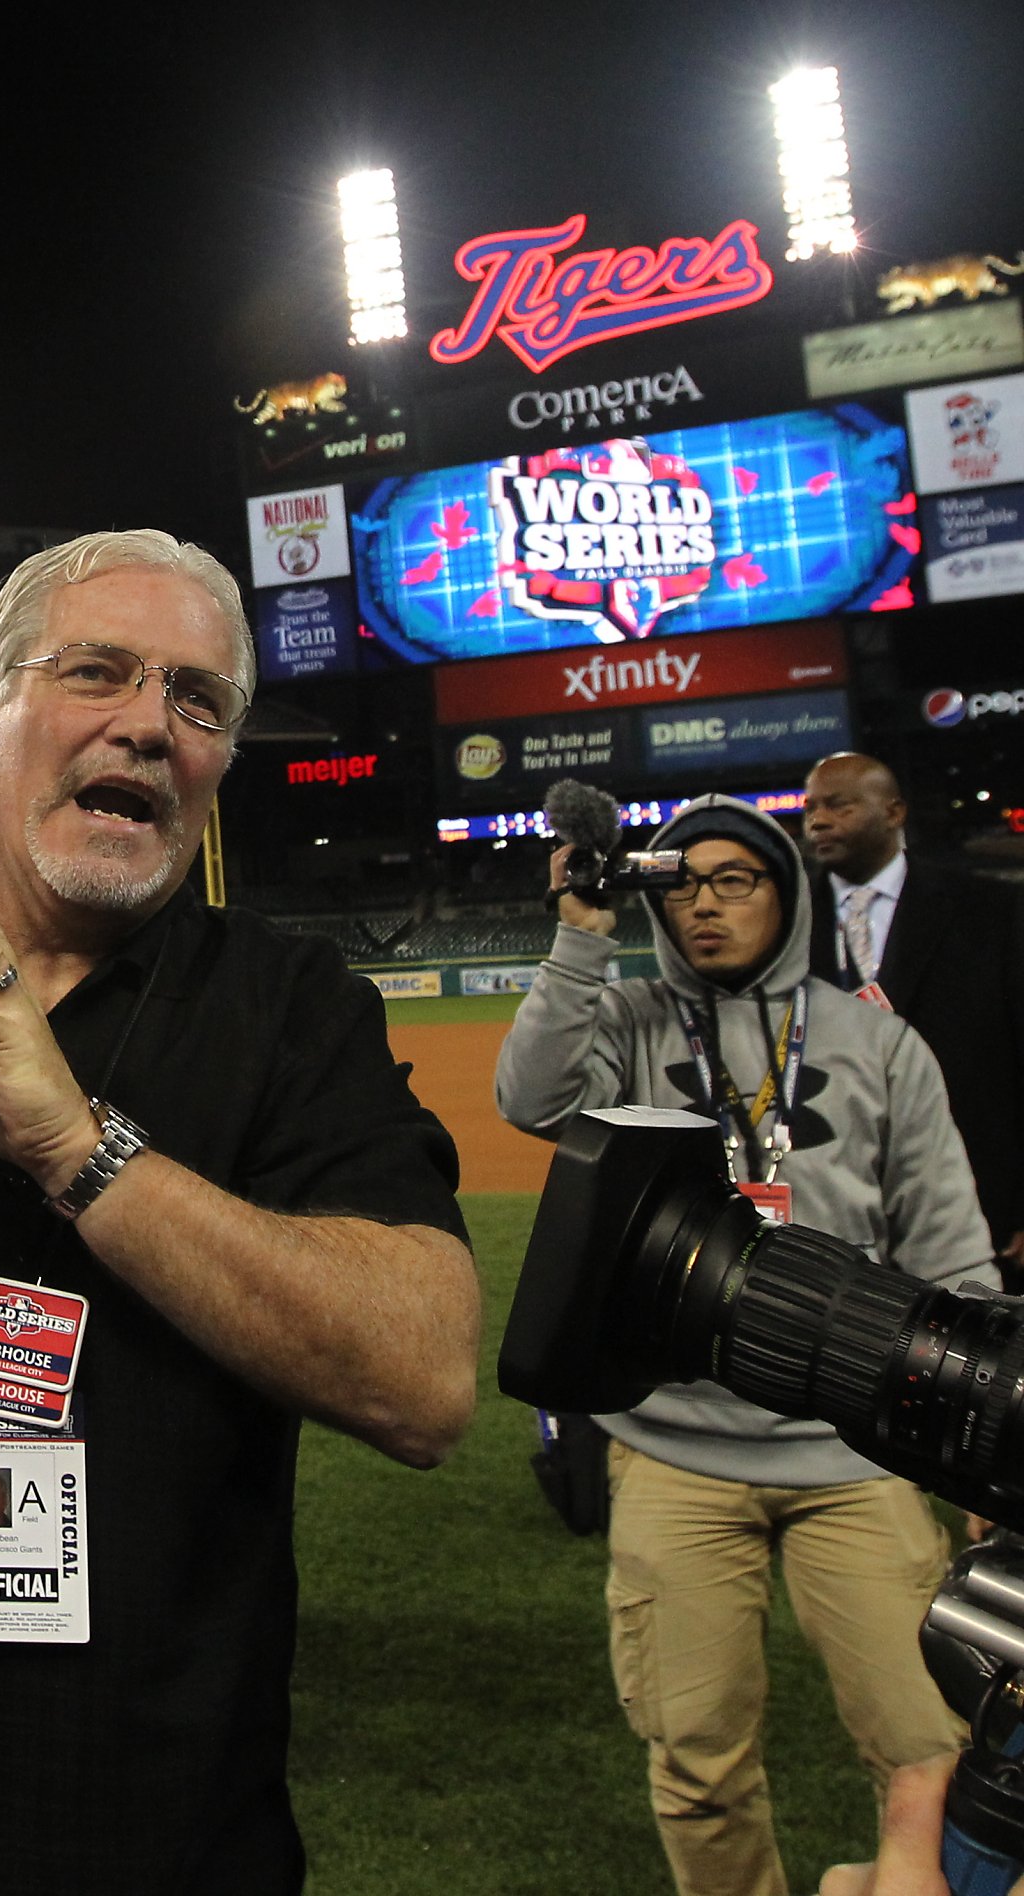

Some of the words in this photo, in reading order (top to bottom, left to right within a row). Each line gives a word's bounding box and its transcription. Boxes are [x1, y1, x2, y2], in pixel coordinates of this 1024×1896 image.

[429, 214, 773, 373] Tigers
[562, 402, 653, 433] PARK
[323, 432, 407, 459] verion
[263, 494, 330, 528] NATIONAL
[514, 476, 713, 524] WORLD
[524, 523, 716, 572] SERIES
[279, 612, 309, 626] Trust
[312, 610, 330, 622] the
[275, 625, 336, 649] Team
[279, 649, 302, 663] that
[303, 646, 336, 660] treats
[293, 661, 324, 675] yours
[563, 649, 702, 702] xfinity
[524, 737, 549, 751] One
[551, 734, 584, 749] Taste
[587, 729, 612, 746] and
[650, 717, 726, 746] DMC
[731, 719, 789, 742] always
[288, 754, 378, 786] meijer
[523, 754, 562, 770] You're
[581, 749, 611, 765] Love
[740, 1241, 756, 1265] JAPAN
[18, 1311, 74, 1333] SERIES
[2, 1361, 27, 1373] LEAGUE
[28, 1366, 43, 1376] CITY
[20, 1404, 36, 1414] CITY
[18, 1480, 47, 1514] A
[22, 1515, 39, 1523] Field
[60, 1473, 79, 1579] OFFICIAL
[20, 1545, 43, 1554] Giants
